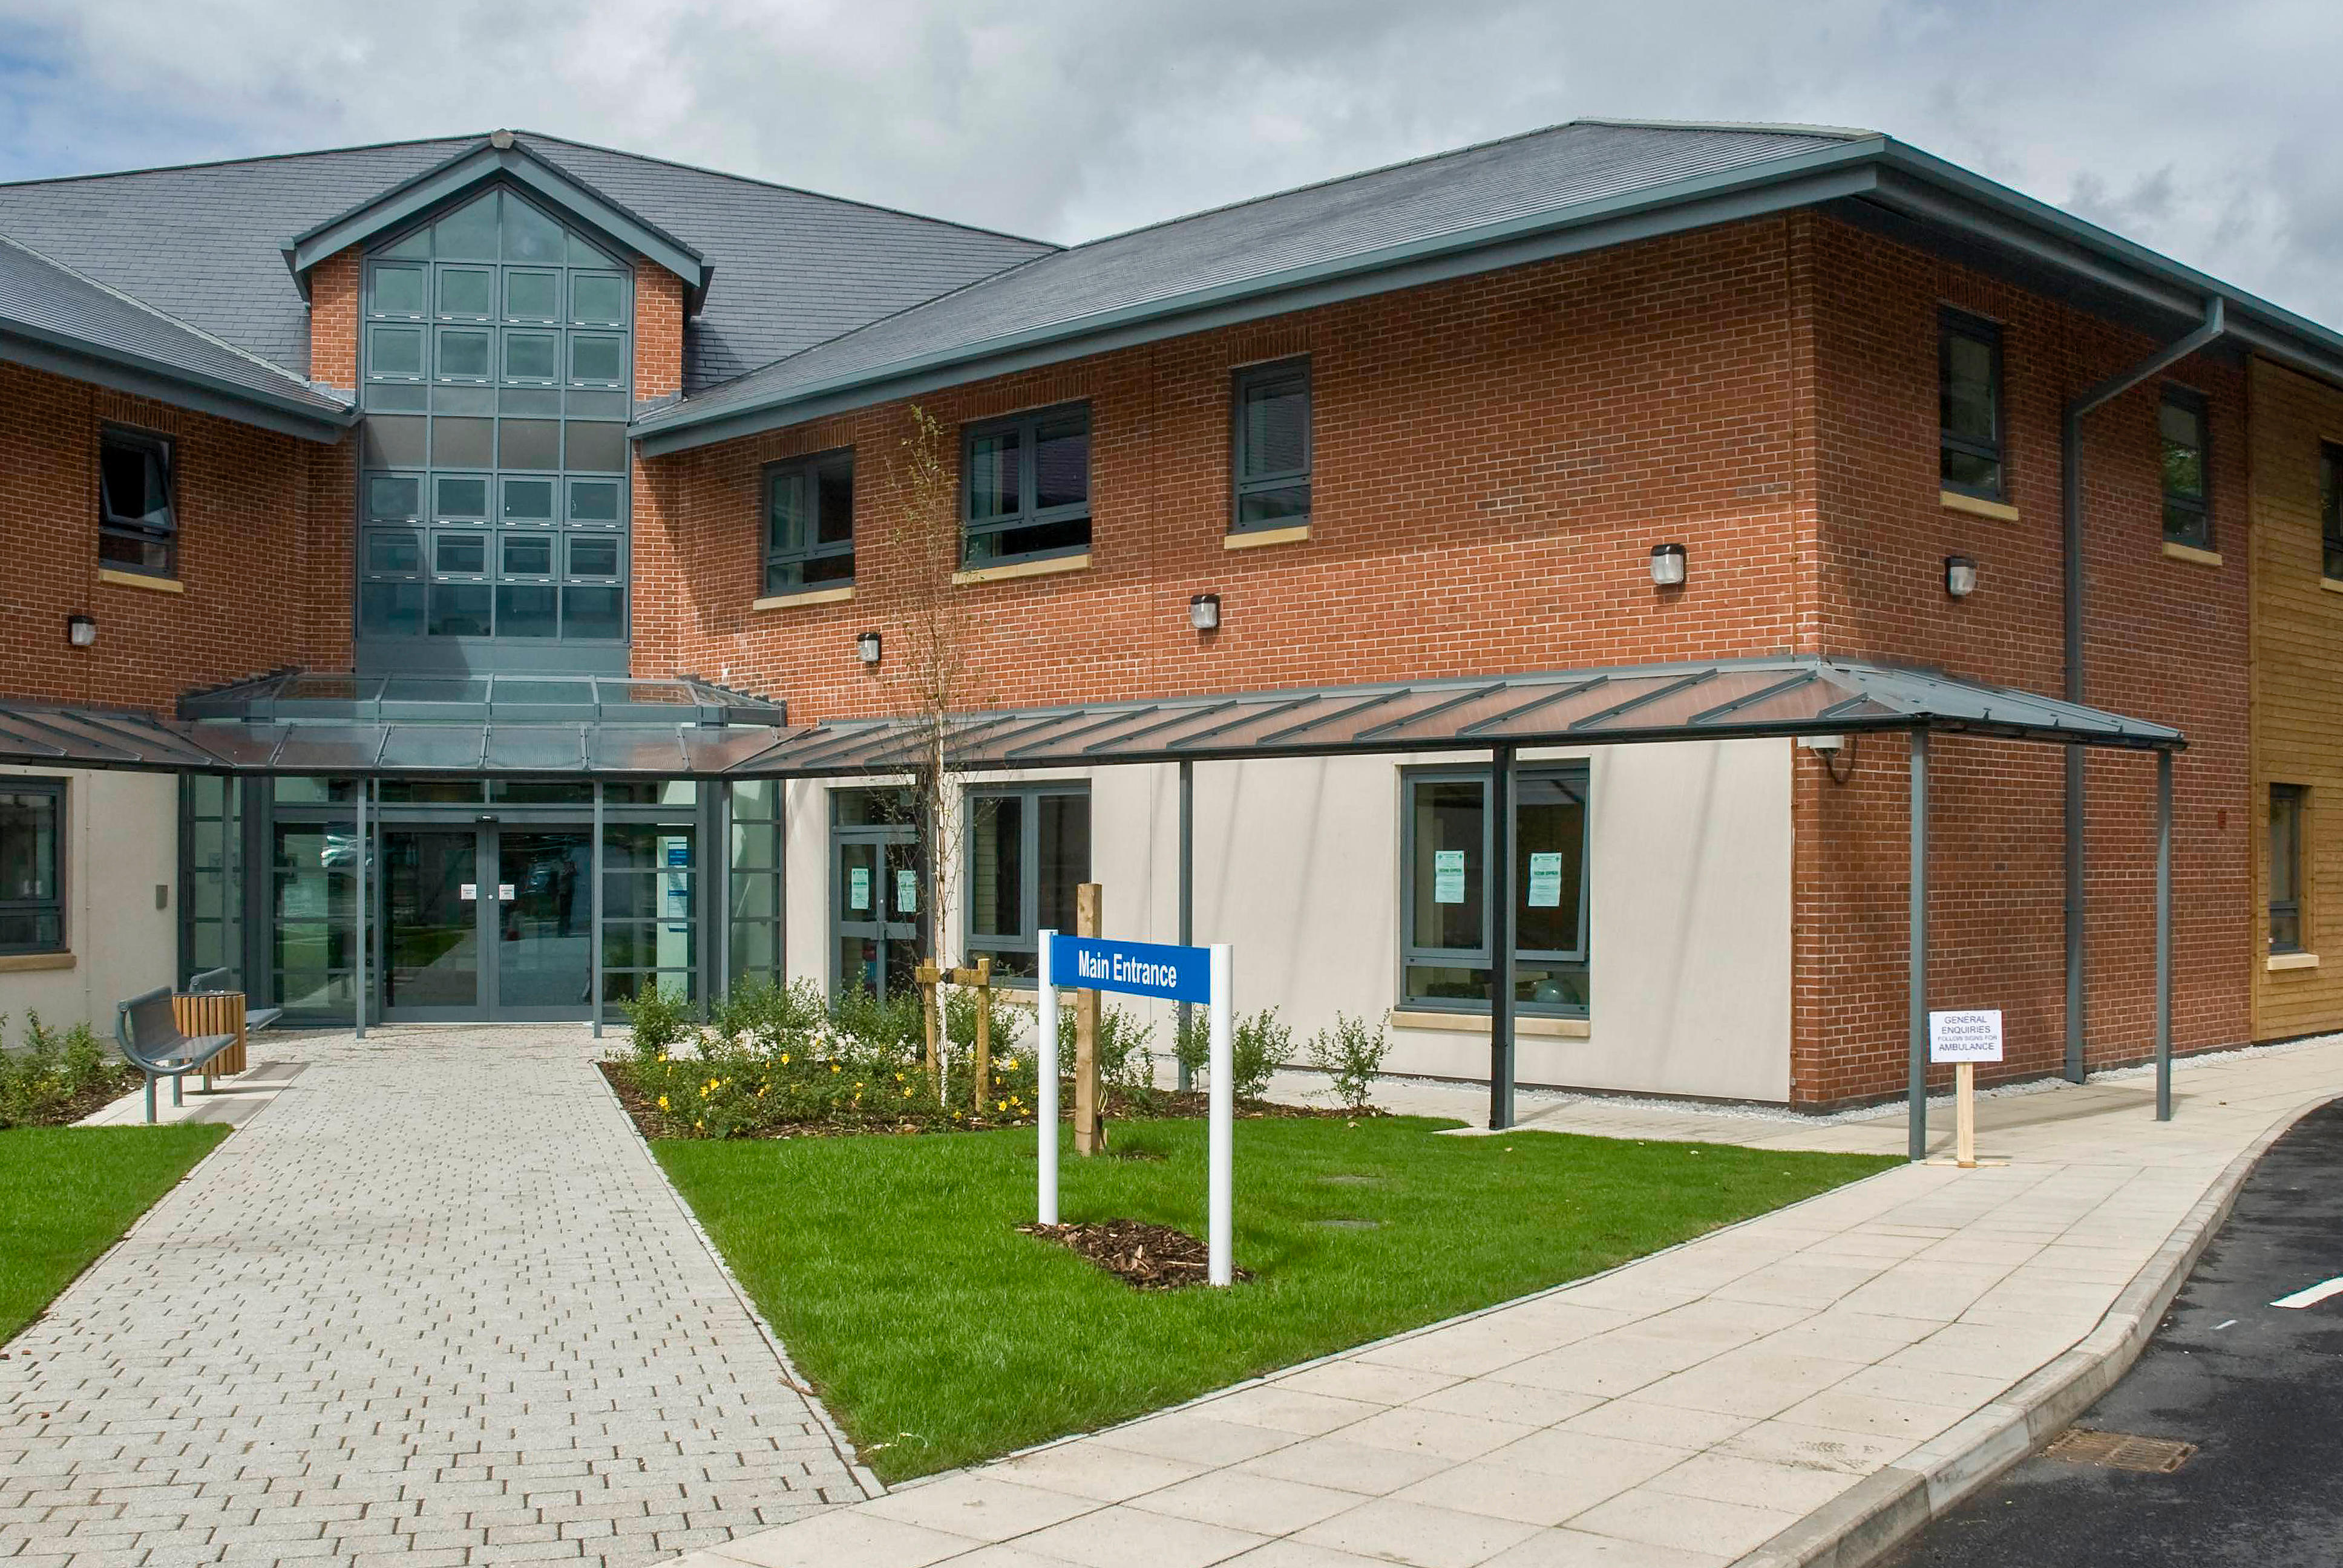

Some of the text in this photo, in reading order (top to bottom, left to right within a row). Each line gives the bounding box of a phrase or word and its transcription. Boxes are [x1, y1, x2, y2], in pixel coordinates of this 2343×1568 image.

[1078, 949, 1177, 988] Main Entrance
[1944, 1016, 1988, 1024] GENERAL
[1941, 1025, 1991, 1034] ENQUIRIES
[1938, 1042, 1995, 1051] AMBULANCE
